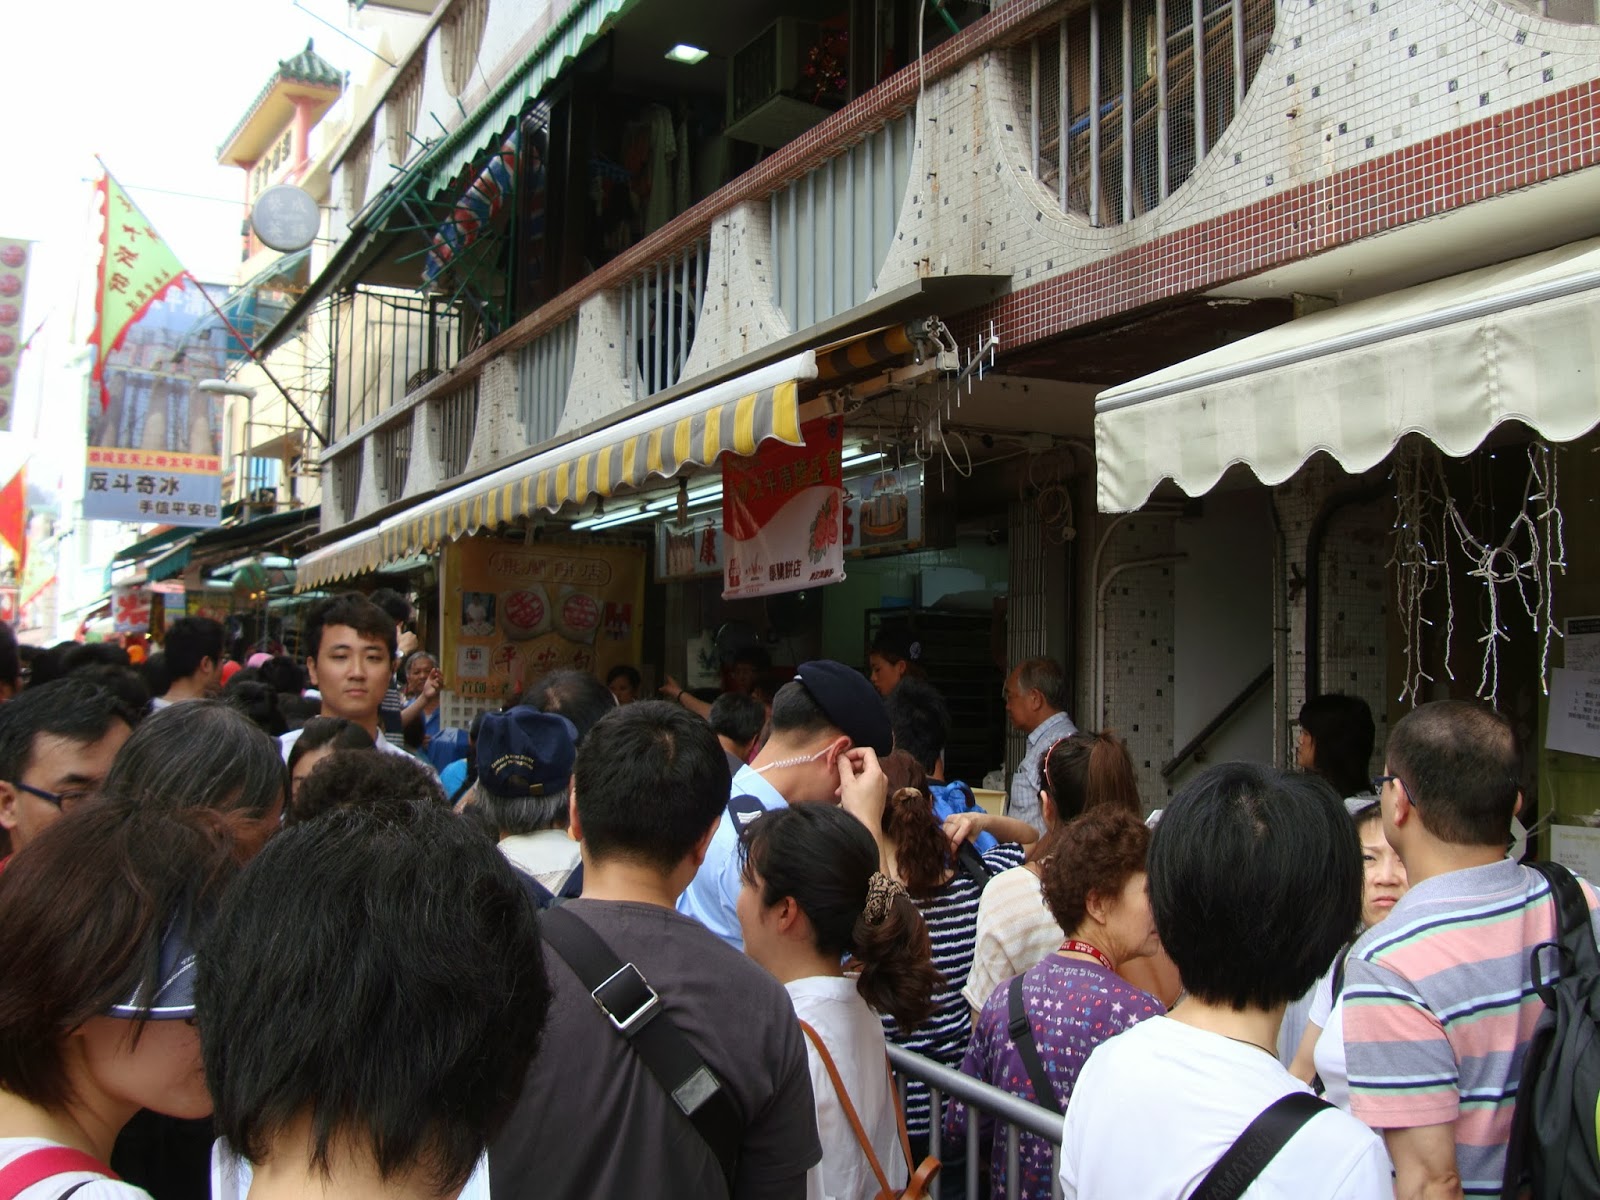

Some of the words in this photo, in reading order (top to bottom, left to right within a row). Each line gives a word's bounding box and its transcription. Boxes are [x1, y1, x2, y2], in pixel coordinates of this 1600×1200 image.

[88, 472, 180, 496] 反斗奇冰
[1049, 964, 1078, 976] Jungle
[1079, 968, 1106, 982] Story
